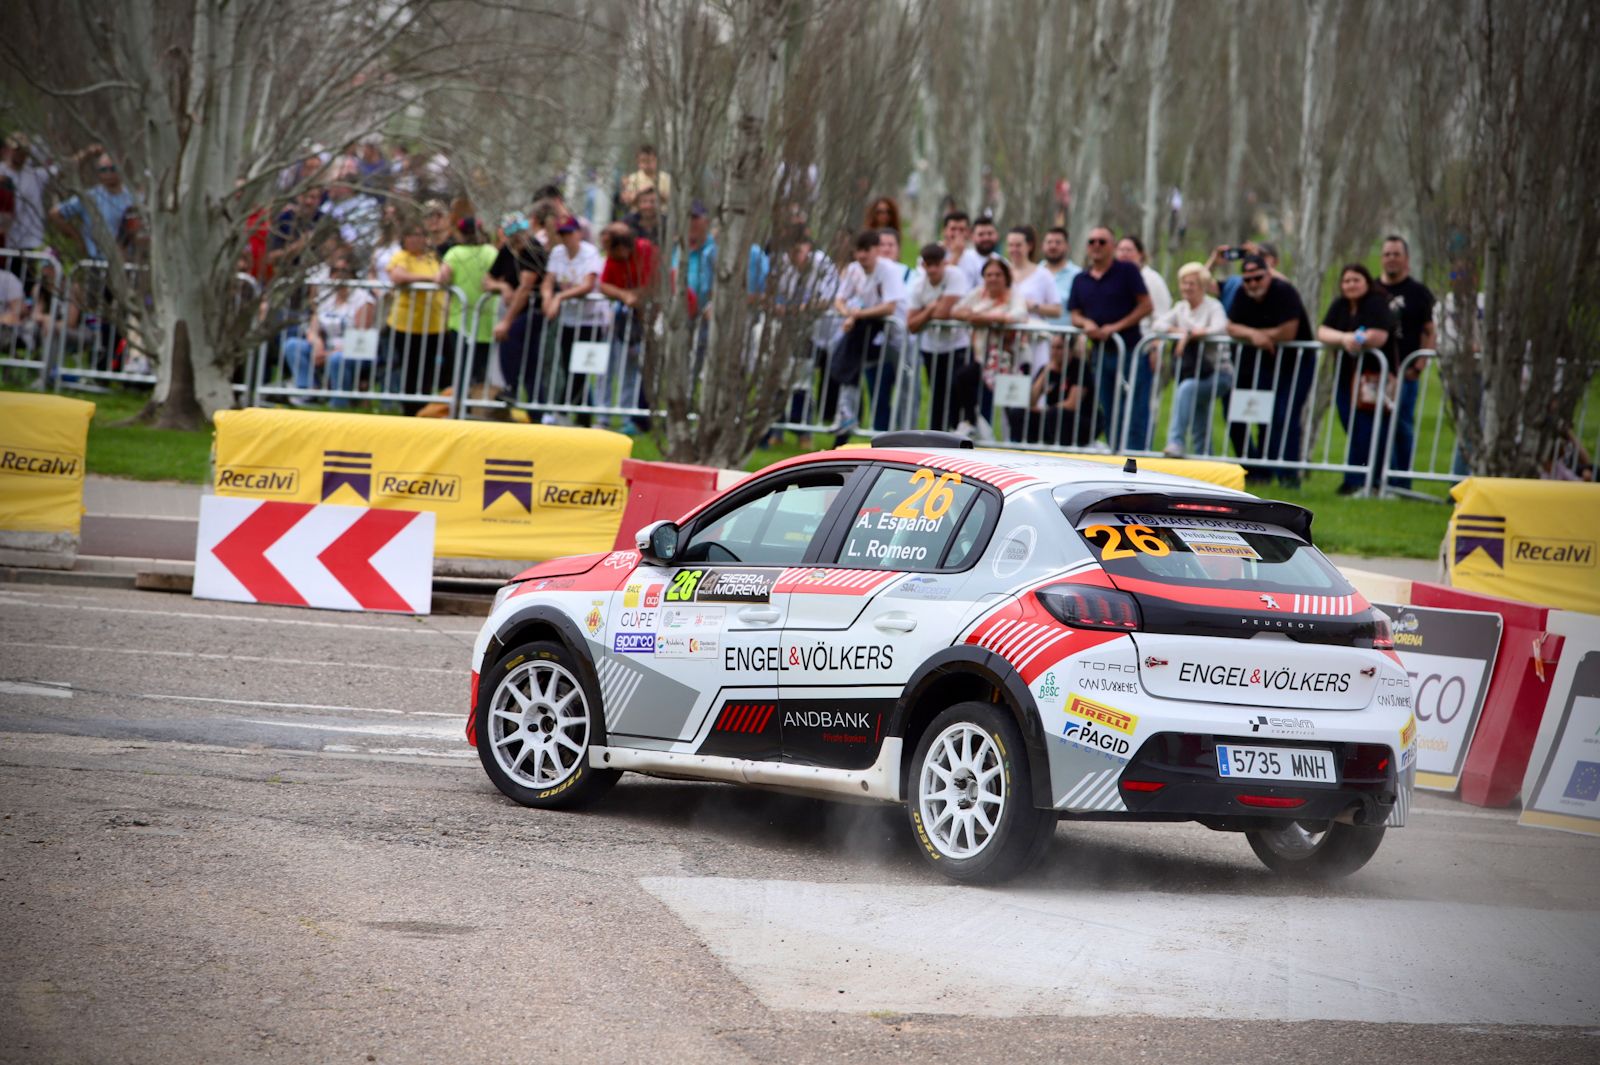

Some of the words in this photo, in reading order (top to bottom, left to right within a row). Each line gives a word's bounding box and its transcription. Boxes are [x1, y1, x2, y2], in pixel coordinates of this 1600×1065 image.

[1, 450, 78, 476] Recalvi
[218, 469, 295, 491] Recalvi
[382, 476, 457, 497] Recalvi
[543, 486, 618, 507] Recalvi
[889, 468, 962, 520] 26
[856, 512, 873, 529] A.
[877, 512, 944, 533] Español
[1158, 516, 1197, 526] RACE
[1198, 518, 1225, 528] FOR
[1226, 520, 1267, 532] GOOD
[848, 539, 861, 557] L.
[866, 540, 927, 560] Romero
[1084, 524, 1170, 561] 26
[1206, 544, 1243, 554] Recalvi
[1515, 541, 1591, 563] Recalvi
[666, 570, 703, 601] 26
[718, 573, 764, 584] SIERRA
[714, 584, 768, 596] MORENA
[1241, 618, 1315, 629] PEUGEOT
[616, 635, 654, 652] sparco
[725, 641, 894, 671] ENGEL&VÖLKERS
[1079, 661, 1136, 673] TORO
[1179, 662, 1351, 692] ENGEL&VÖLKERS
[1079, 678, 1101, 690] CAN
[1381, 677, 1410, 687] TORO
[783, 711, 870, 728] ANDBANK
[1071, 698, 1131, 730] PIRELLI
[1079, 726, 1130, 754] PAGID
[1059, 738, 1131, 765] RACING
[1232, 750, 1281, 775] 5735
[1291, 754, 1327, 779] MNH
[540, 776, 577, 798] ZERO
[913, 812, 935, 856] ZERO
